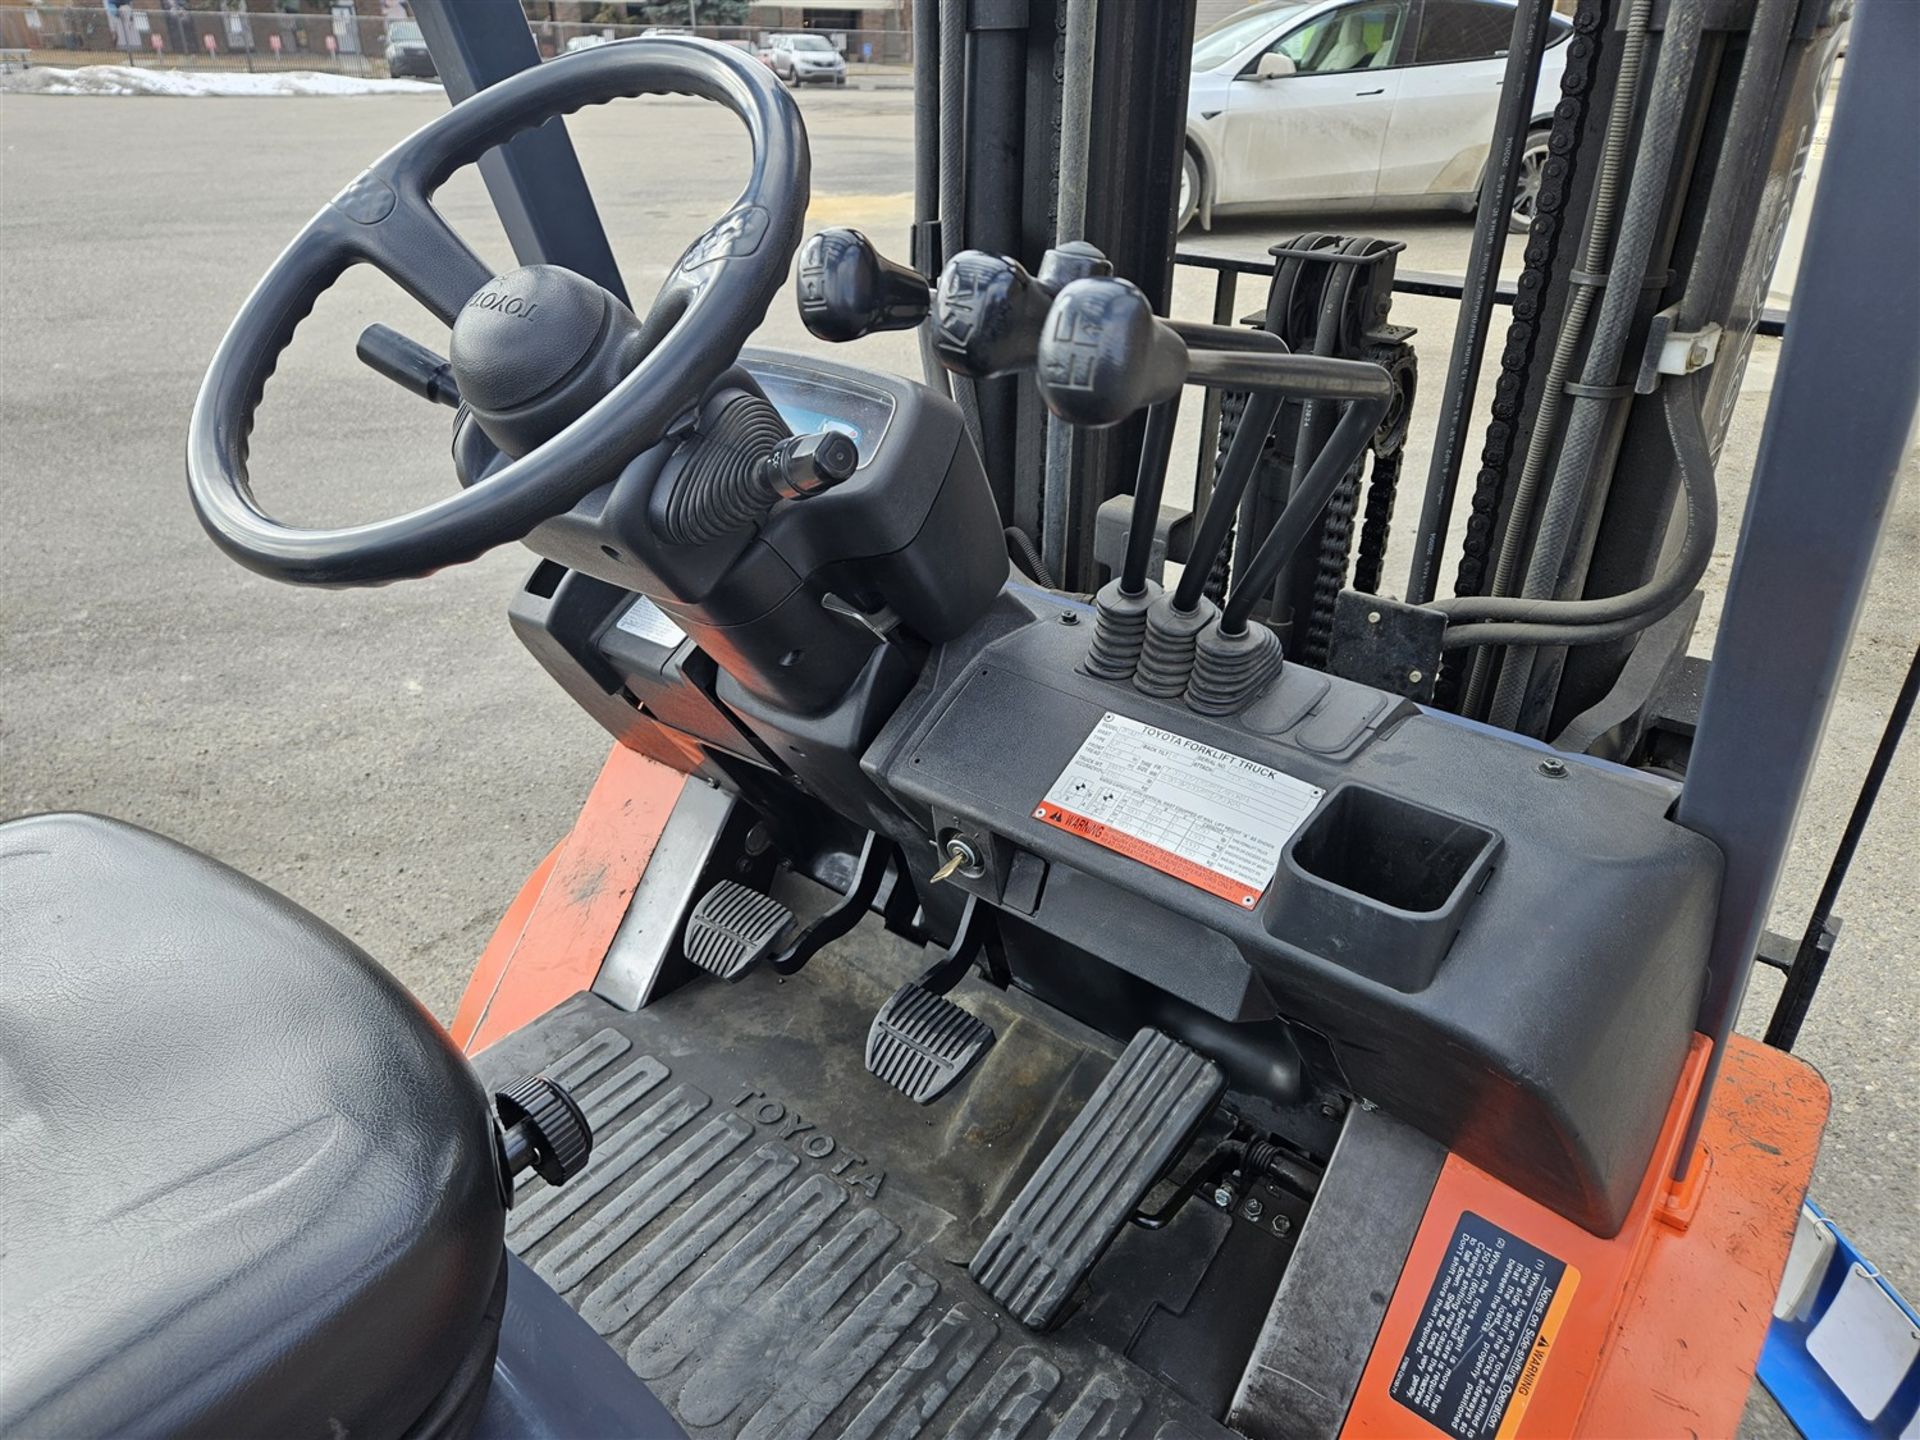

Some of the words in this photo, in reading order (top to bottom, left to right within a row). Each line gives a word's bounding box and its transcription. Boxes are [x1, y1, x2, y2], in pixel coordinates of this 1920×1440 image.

[469, 291, 538, 321] TOYOT
[1140, 725, 1183, 745] TOYOTA
[1182, 740, 1236, 764] FORKLIFT
[1236, 759, 1278, 779] TRUCK
[1063, 813, 1106, 838] WARNING
[728, 1083, 889, 1200] TOYOTA
[1454, 1232, 1469, 1256] Don't
[1468, 1236, 1477, 1246] to
[1494, 1236, 1506, 1249] (2)
[1464, 1241, 1485, 1279] Careless
[1480, 1245, 1493, 1263] 150
[1484, 1249, 1501, 1275] When
[1534, 1258, 1545, 1271] (1)
[1447, 1255, 1460, 1275] shift
[1474, 1263, 1484, 1277] cm
[1511, 1262, 1523, 1281] that
[1519, 1266, 1530, 1284] one
[1438, 1275, 1451, 1297] more
[1477, 1278, 1489, 1294] the
[1495, 1258, 1515, 1294] between
[1524, 1271, 1540, 1297] When
[1450, 1278, 1470, 1311] shifting
[1490, 1294, 1501, 1309] the
[1503, 1284, 1514, 1300] the
[1508, 1286, 1523, 1309] side,
[1520, 1298, 1528, 1306] a
[1534, 1285, 1552, 1315] Notes
[1430, 1297, 1443, 1318] than
[1466, 1297, 1481, 1320] forks
[1493, 1304, 1506, 1325] load
[1511, 1307, 1526, 1329] load
[1435, 1313, 1446, 1328] the
[1442, 1310, 1455, 1330] may
[1448, 1307, 1467, 1339] special
[1500, 1311, 1513, 1332] shift
[1528, 1313, 1539, 1327] on
[1425, 1330, 1438, 1351] forks
[1432, 1330, 1448, 1356] cause
[1453, 1322, 1471, 1352] height
[1487, 1328, 1496, 1338] is
[1492, 1334, 1504, 1350] the
[1505, 1329, 1515, 1342] on
[1440, 1339, 1453, 1360] care
[1449, 1354, 1458, 1364] is
[1498, 1343, 1510, 1359] the
[1503, 1326, 1535, 1385] Side-shifting
[1415, 1353, 1428, 1371] very
[1426, 1357, 1437, 1372] the
[1436, 1360, 1446, 1370] is
[1481, 1352, 1496, 1376] forks
[1488, 1360, 1503, 1384] forks
[1517, 1348, 1544, 1397] WARNING
[1412, 1372, 1431, 1404] machine
[1438, 1367, 1452, 1391] more
[1462, 1377, 1486, 1419] sideways
[1484, 1385, 1493, 1395] is
[1428, 1393, 1442, 1414] than
[1449, 1381, 1474, 1429] positioned
[1470, 1396, 1489, 1427] shifted
[1485, 1382, 1512, 1429] Operation
[1458, 1421, 1467, 1433] so
[1466, 1427, 1476, 1439] to
